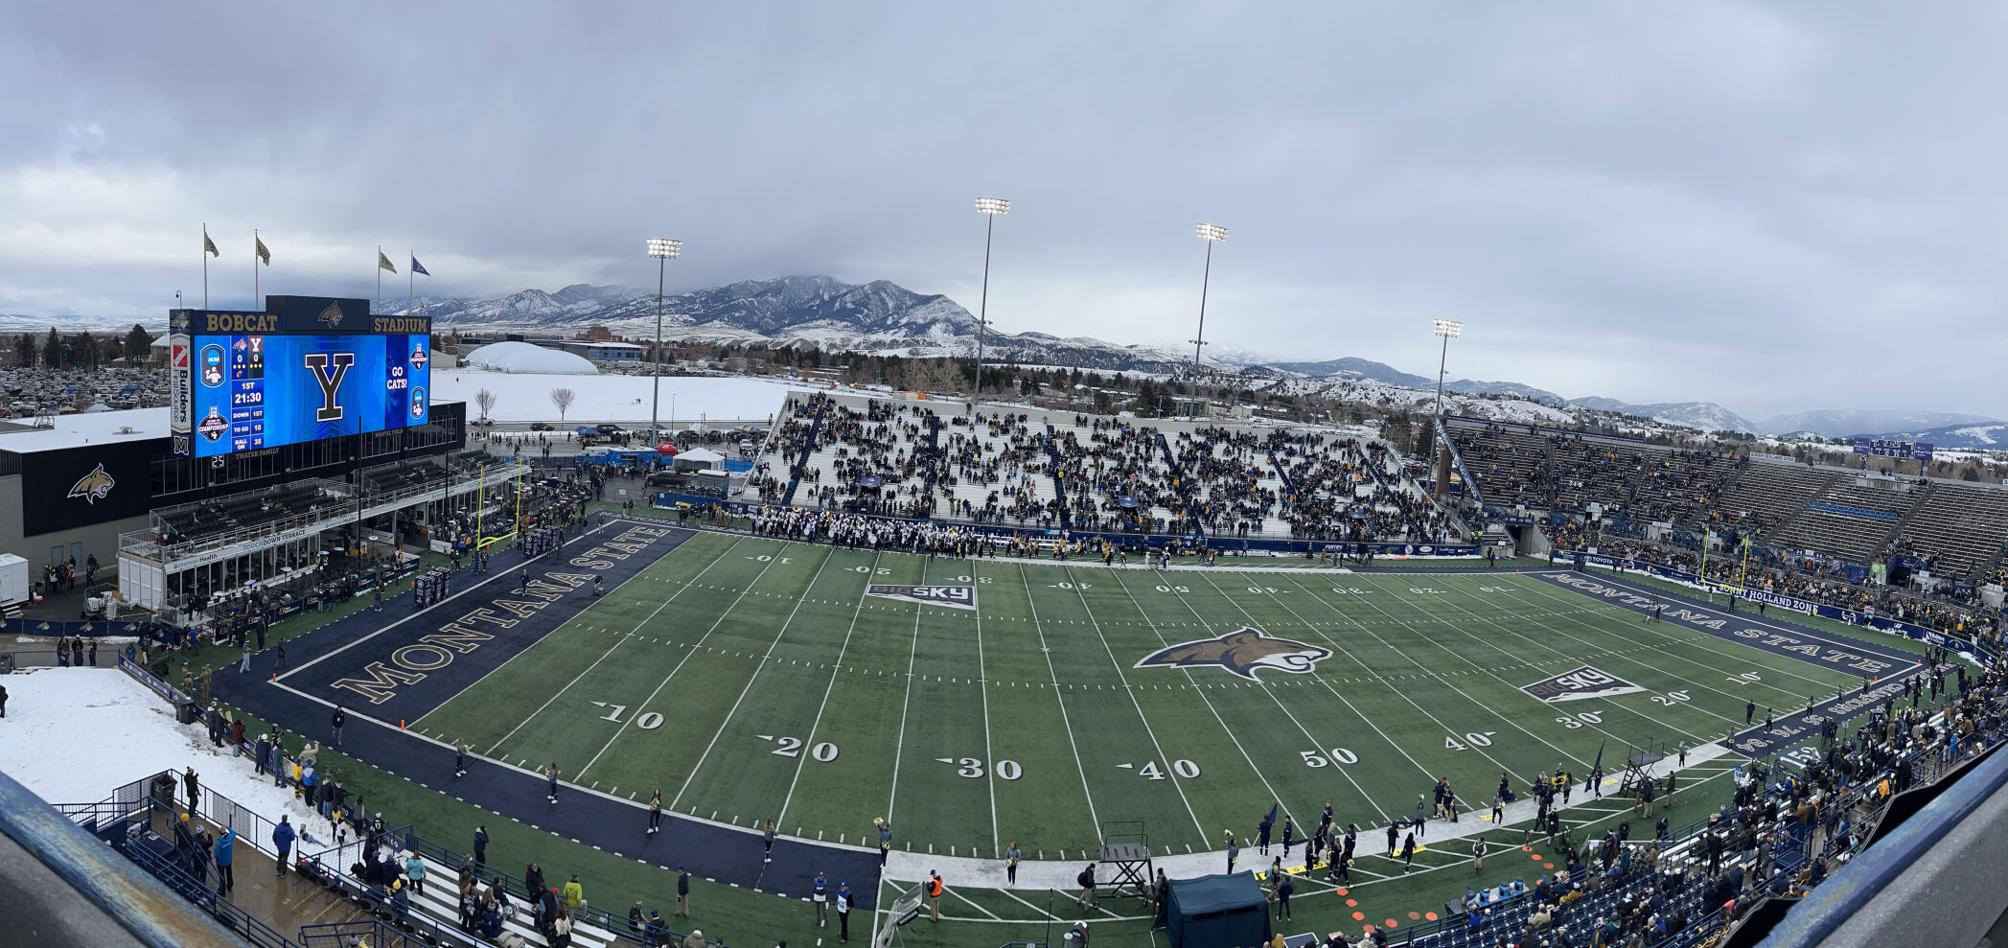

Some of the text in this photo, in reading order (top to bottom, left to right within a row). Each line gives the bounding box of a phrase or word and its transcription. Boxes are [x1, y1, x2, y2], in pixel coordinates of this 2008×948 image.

[206, 314, 277, 332] BOBCAT
[374, 317, 427, 333] STADIUM
[250, 338, 261, 352] Y
[392, 366, 403, 377] GO
[241, 382, 255, 390] 1ST
[305, 353, 354, 422] Y
[387, 379, 407, 390] CATS!
[180, 369, 188, 423] Builders
[234, 392, 262, 404] 21:30
[174, 436, 189, 455] M
[212, 456, 224, 468] 25
[1593, 556, 1613, 564] TOYOTA
[1749, 590, 1792, 607] HOLLAND
[1793, 600, 1819, 614] ZONE
[330, 525, 671, 705] MONTANA STATE
[1543, 573, 1728, 630] MONTANA
[1734, 628, 1891, 673] STATE
[1726, 672, 1761, 686] 10
[1651, 692, 1690, 707] 20
[599, 703, 665, 730] 10
[1555, 711, 1602, 730] 30
[771, 736, 840, 763] 20
[1445, 731, 1493, 752] 40
[1300, 747, 1360, 769] 50
[958, 757, 1023, 780] 30
[1139, 759, 1200, 781] 40
